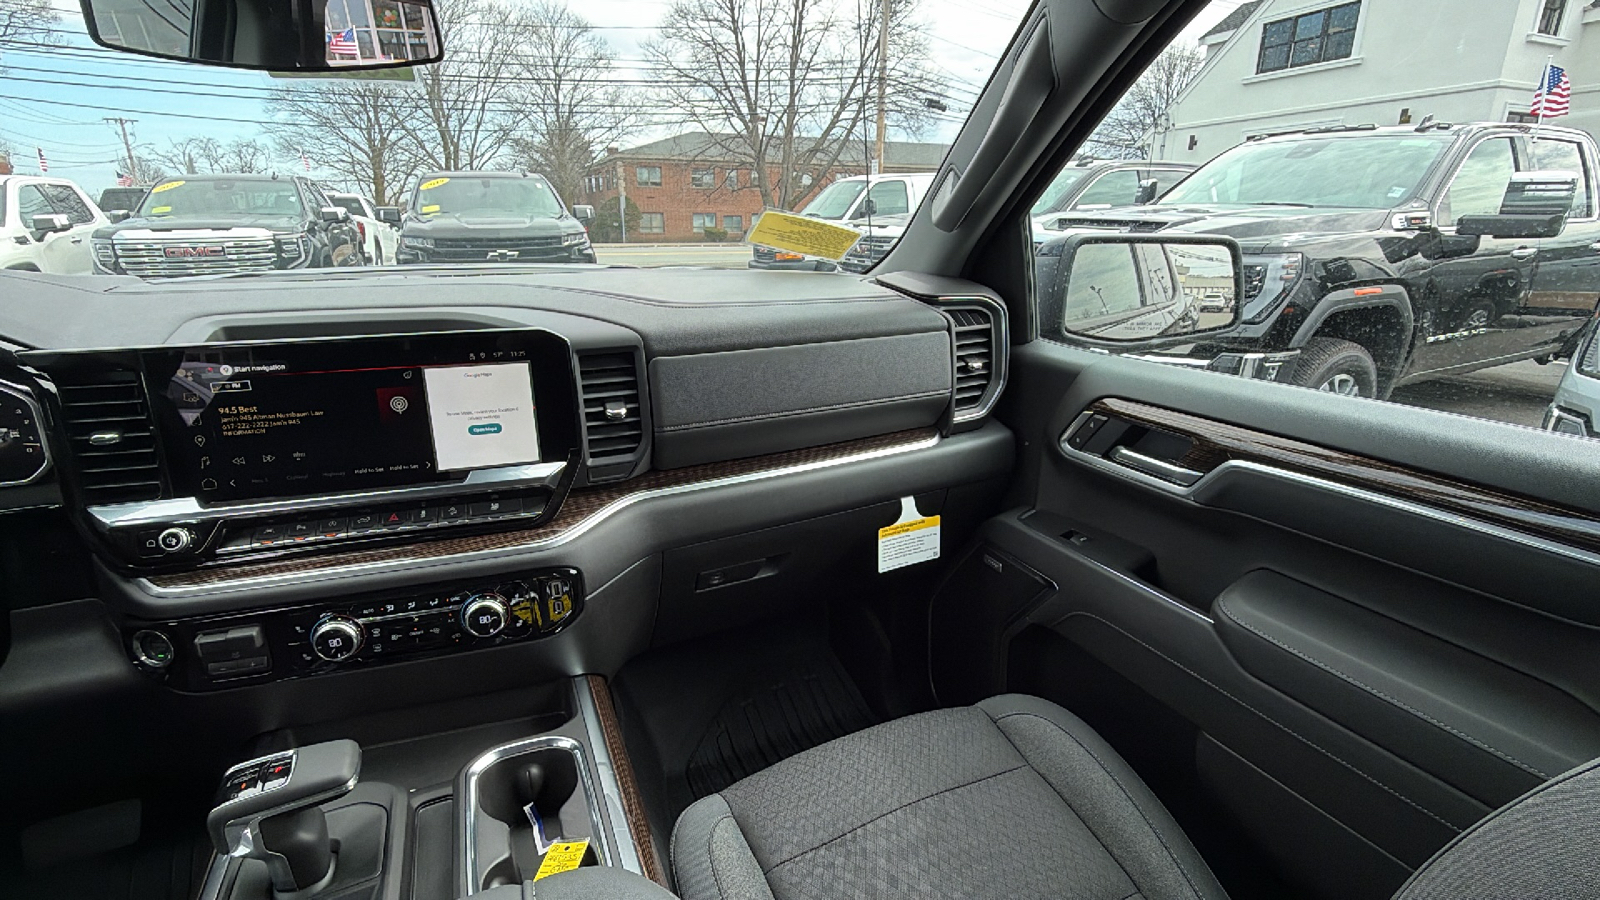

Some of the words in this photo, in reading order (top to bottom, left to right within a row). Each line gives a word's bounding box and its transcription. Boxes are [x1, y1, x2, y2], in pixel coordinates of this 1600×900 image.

[165, 246, 224, 257] GMC
[233, 365, 251, 373] Start
[251, 364, 285, 372] navigation
[222, 421, 269, 430] 617-222-2222
[223, 428, 266, 436] INFORMATION
[479, 615, 490, 623] 80
[328, 637, 342, 647] 80
